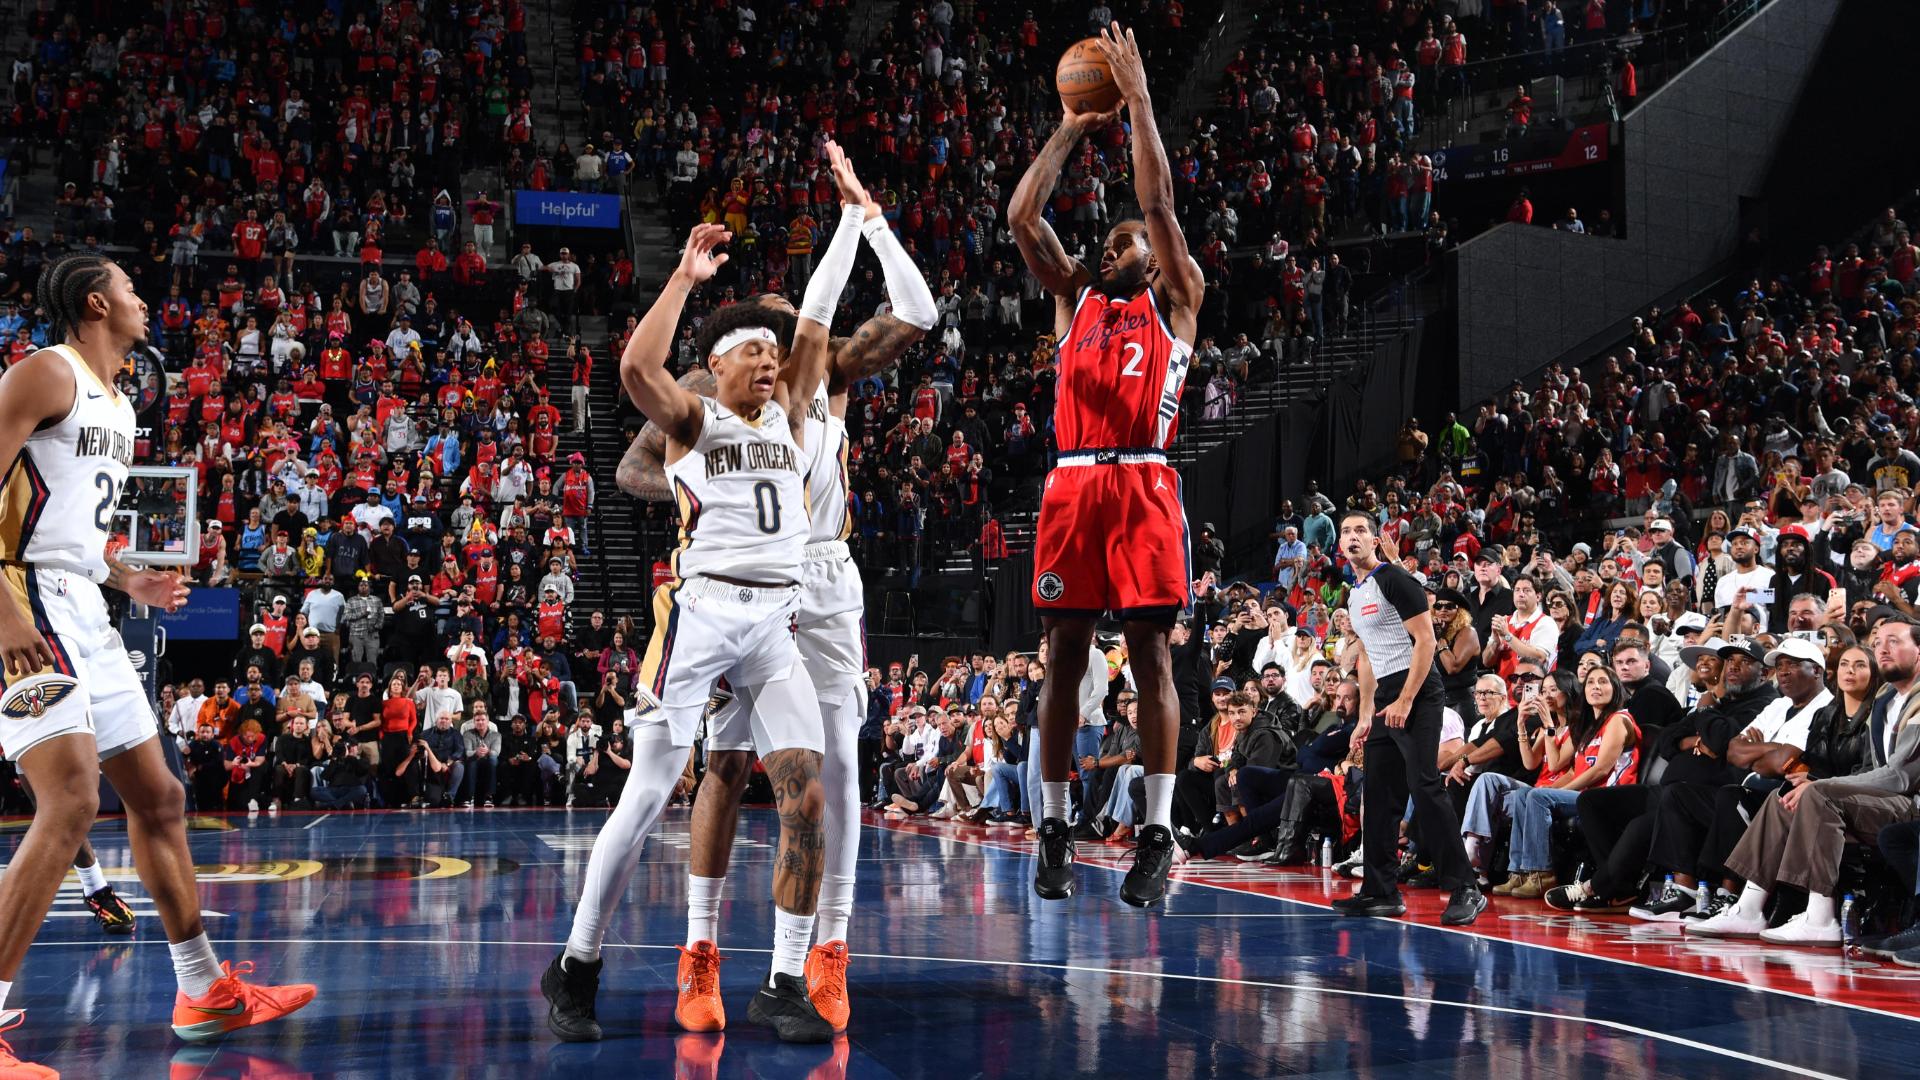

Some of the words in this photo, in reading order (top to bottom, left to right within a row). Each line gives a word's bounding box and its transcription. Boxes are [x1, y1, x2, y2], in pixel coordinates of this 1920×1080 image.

[1493, 148, 1509, 163] 1.6
[1584, 145, 1598, 160] 12
[1432, 168, 1449, 182] 24
[245, 227, 261, 241] 87
[1122, 342, 1144, 377] 2
[230, 428, 240, 436] 26
[76, 427, 110, 458] NEW
[112, 430, 135, 470] ORLE
[704, 443, 742, 481] NEW
[754, 481, 782, 535] 0
[338, 545, 358, 558] GAP
